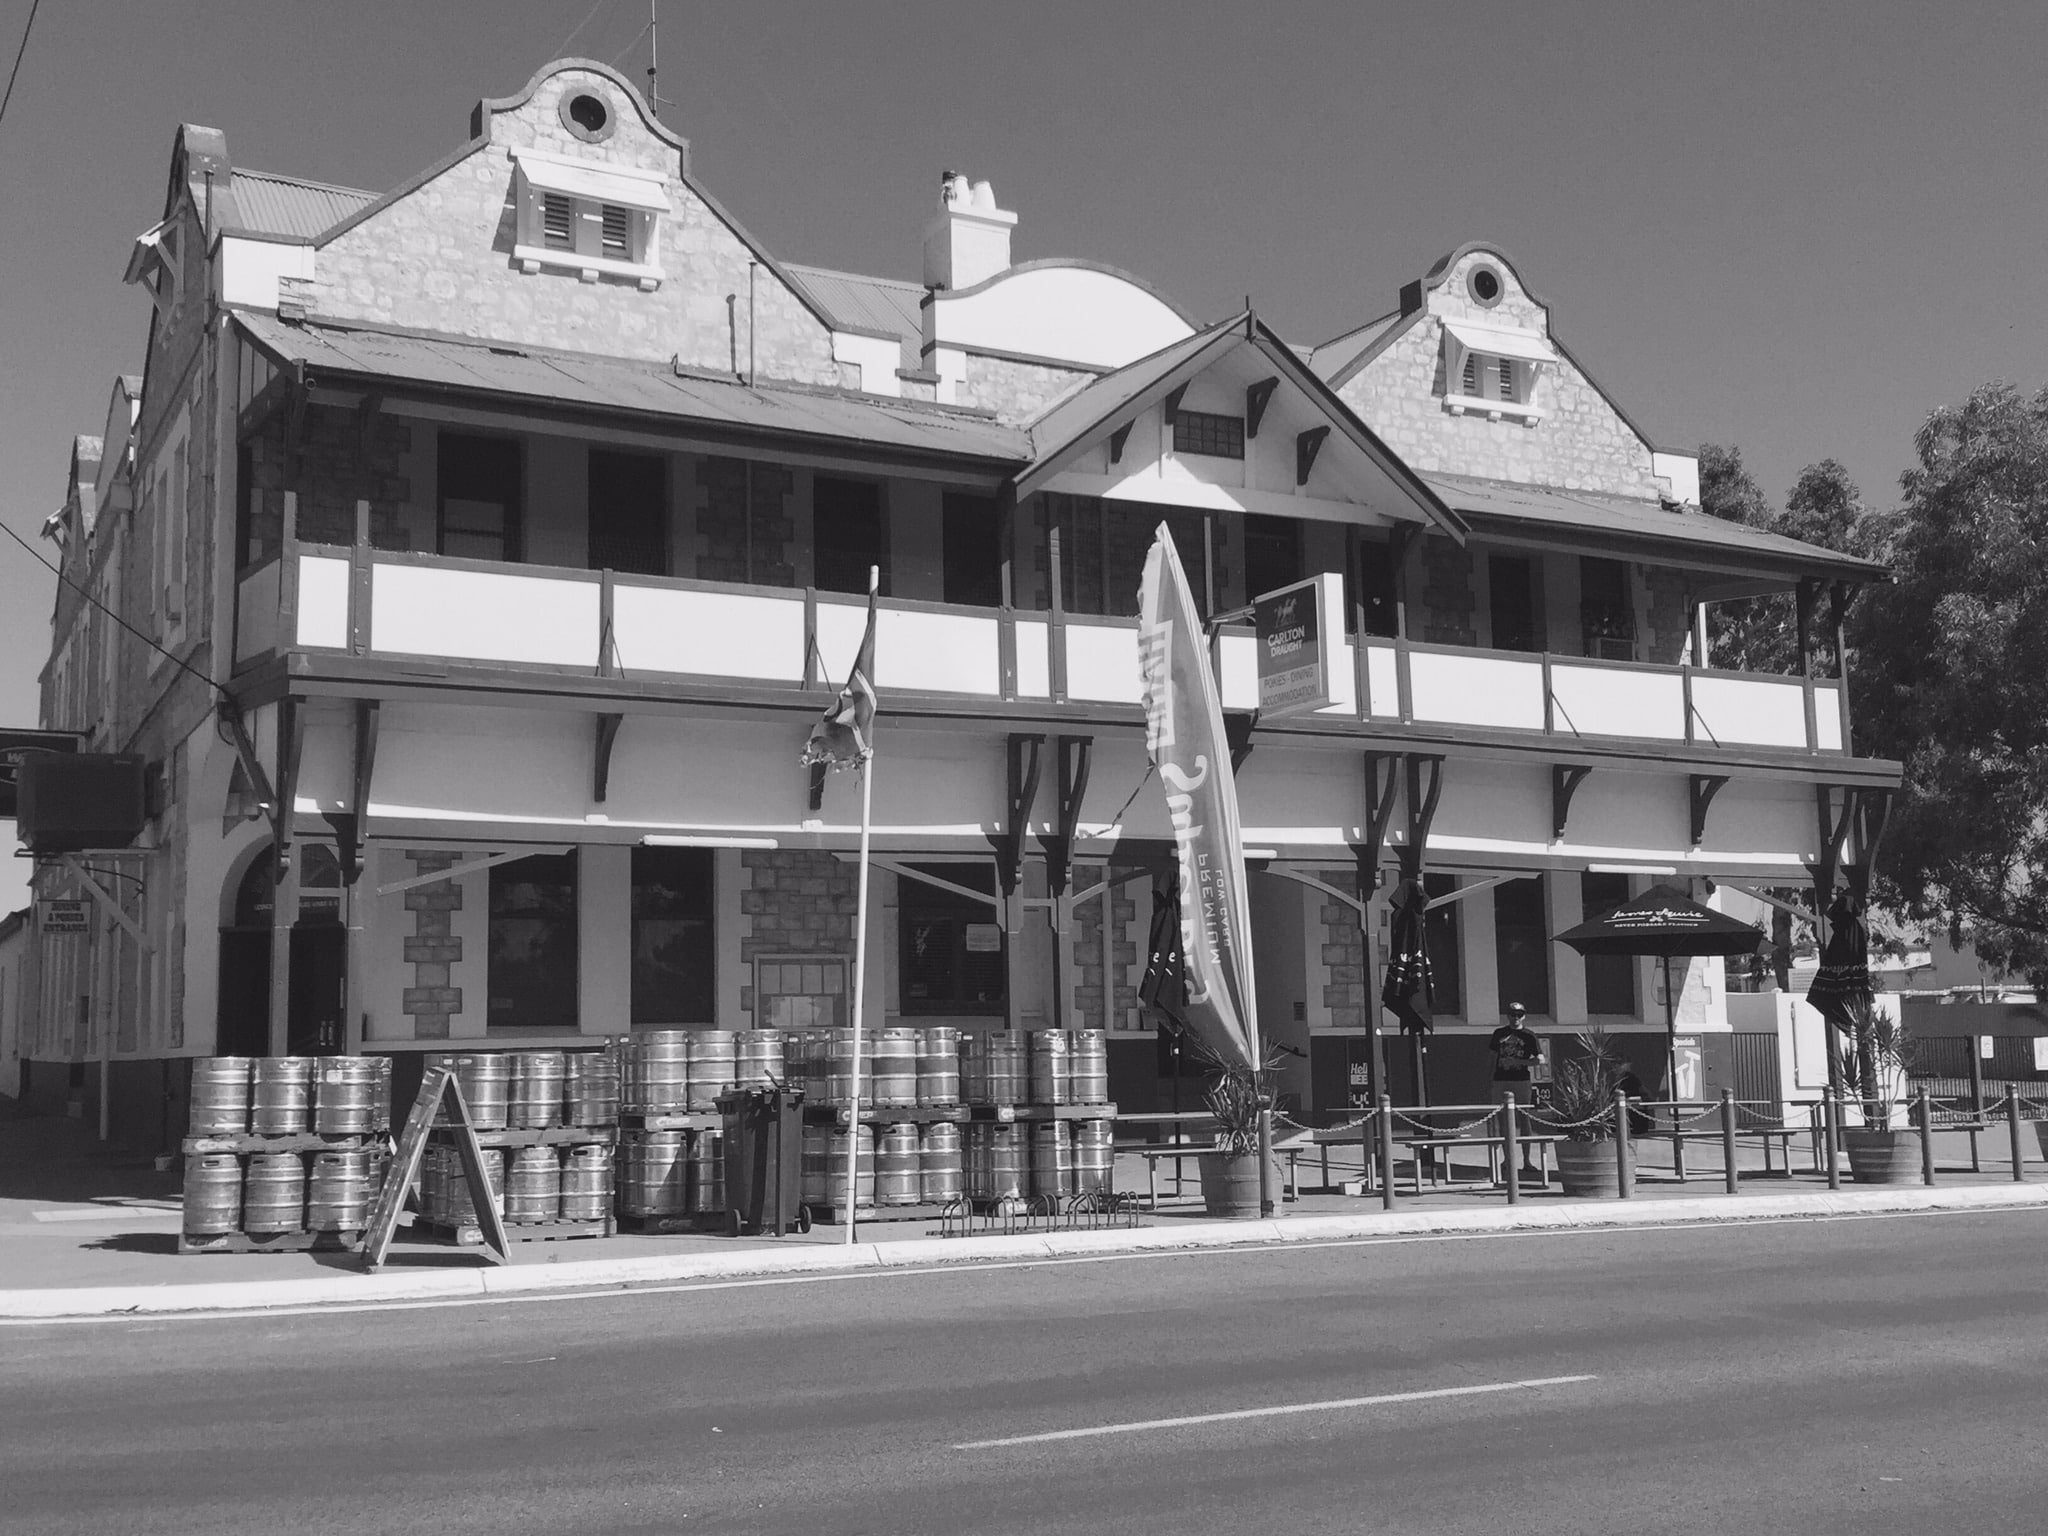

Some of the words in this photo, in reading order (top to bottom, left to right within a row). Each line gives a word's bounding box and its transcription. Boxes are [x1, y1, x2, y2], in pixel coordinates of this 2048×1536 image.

[1268, 625, 1305, 647] CARLTON
[1271, 640, 1303, 658] DRAUGHT
[1264, 675, 1287, 689] POKIES
[1291, 667, 1314, 684] DINING
[1262, 684, 1318, 707] ACCOMMODATION
